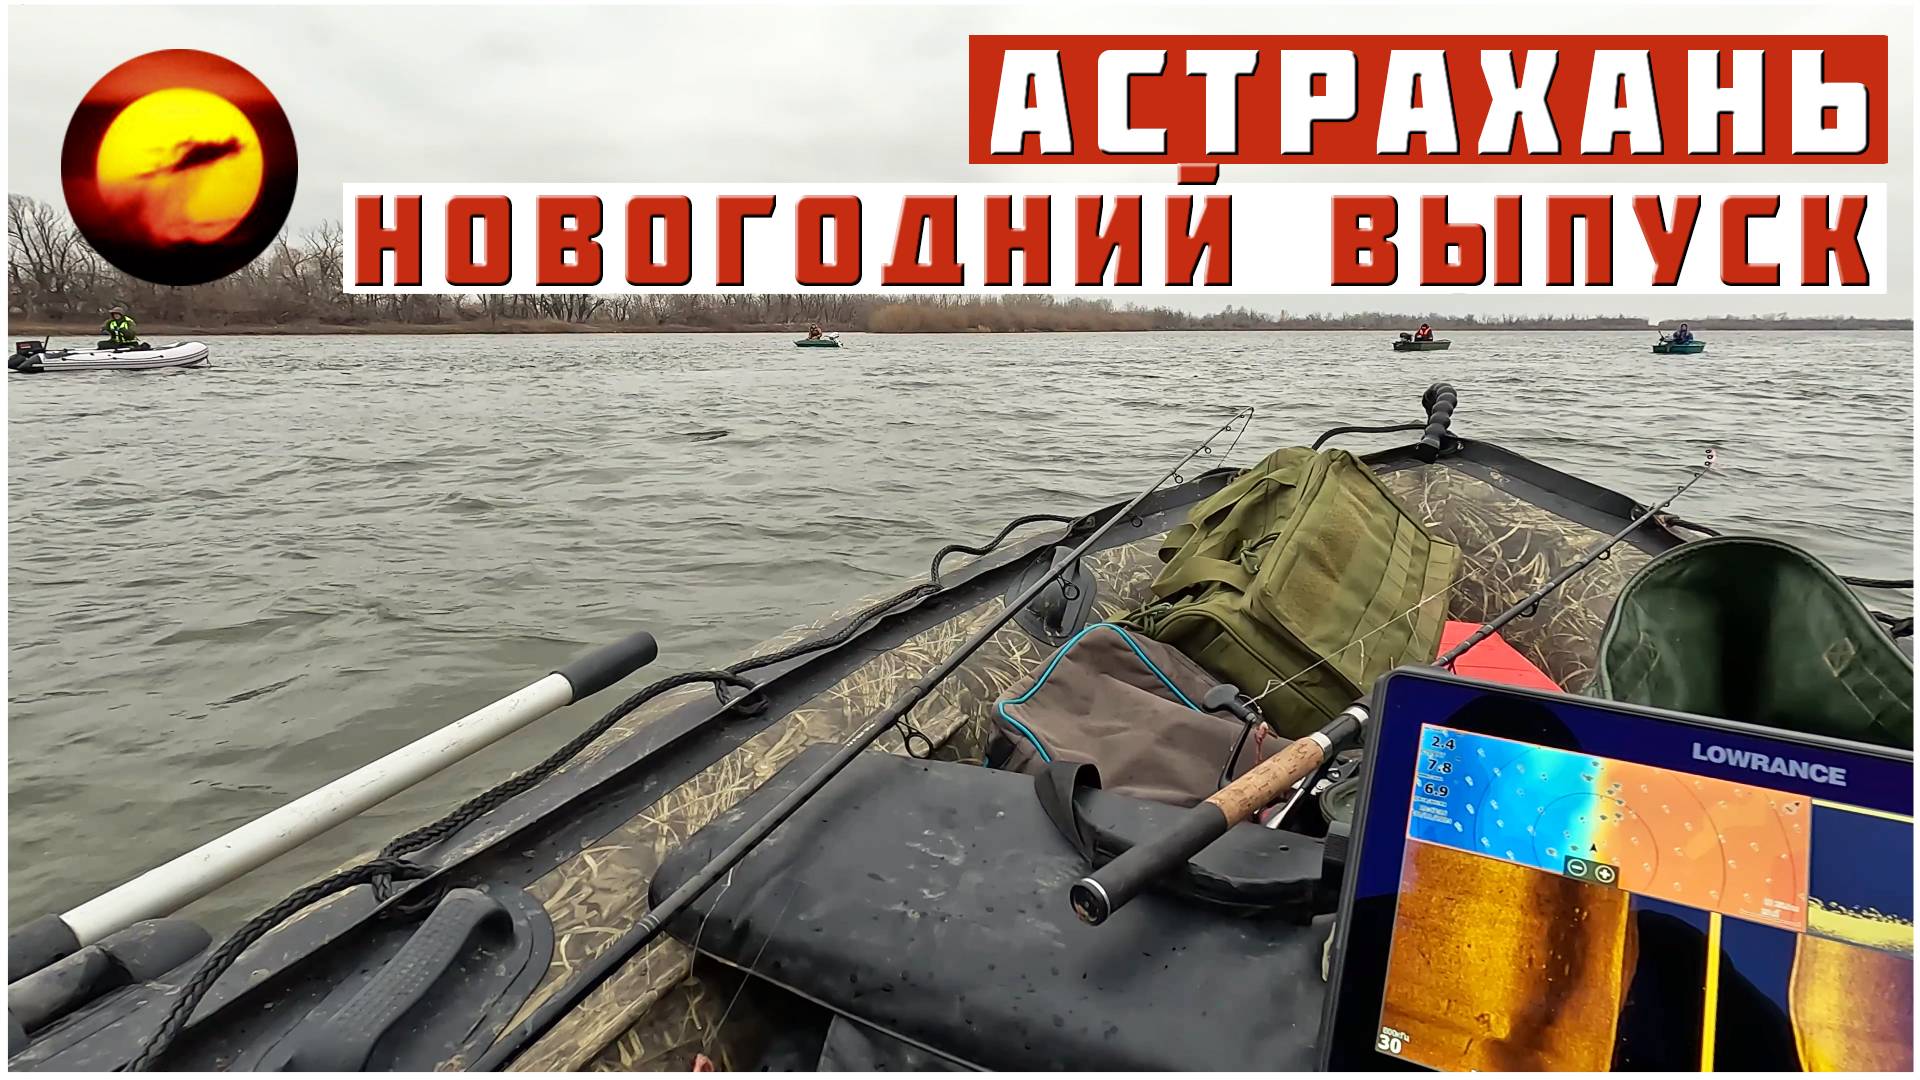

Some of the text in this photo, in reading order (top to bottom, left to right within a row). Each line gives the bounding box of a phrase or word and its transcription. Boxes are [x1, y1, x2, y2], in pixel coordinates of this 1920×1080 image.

[1431, 735, 1456, 751] 2.4
[1427, 758, 1453, 774] 7.8
[1692, 742, 1847, 787] LOWRANCE
[1424, 782, 1449, 798] 6.9
[1377, 1033, 1402, 1054] 30
